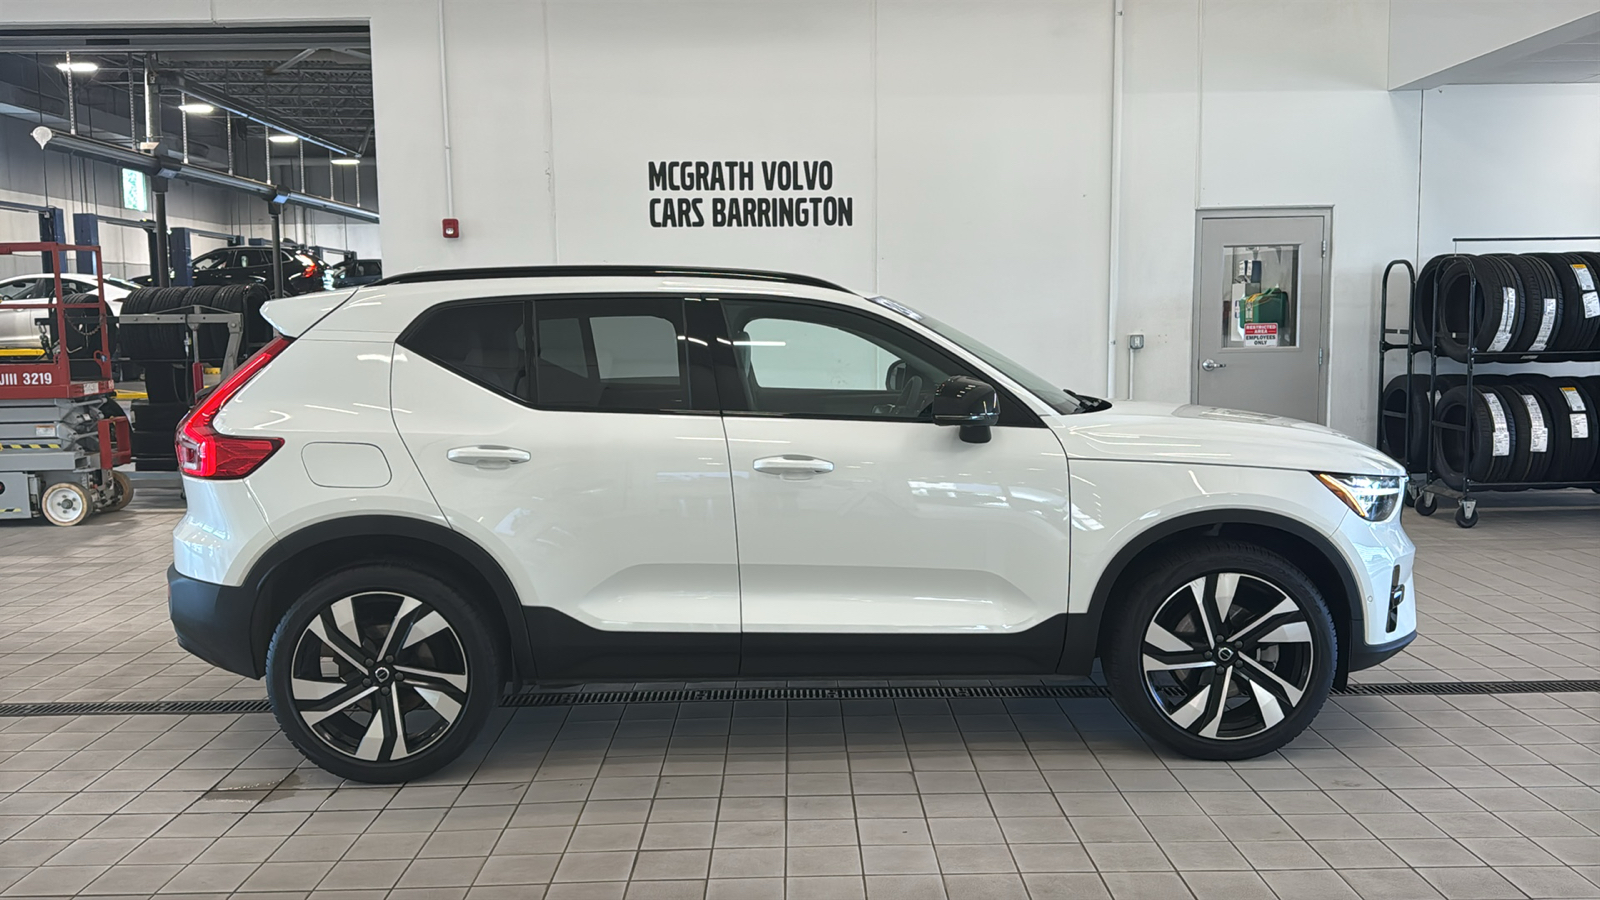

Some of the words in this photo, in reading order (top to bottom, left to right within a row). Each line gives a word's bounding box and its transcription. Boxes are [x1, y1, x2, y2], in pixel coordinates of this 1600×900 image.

[648, 161, 754, 191] MCGRATH
[761, 160, 833, 191] VOLVO
[649, 198, 704, 227] CARS
[712, 196, 853, 227] BARRINGTON
[22, 372, 52, 385] 3219
